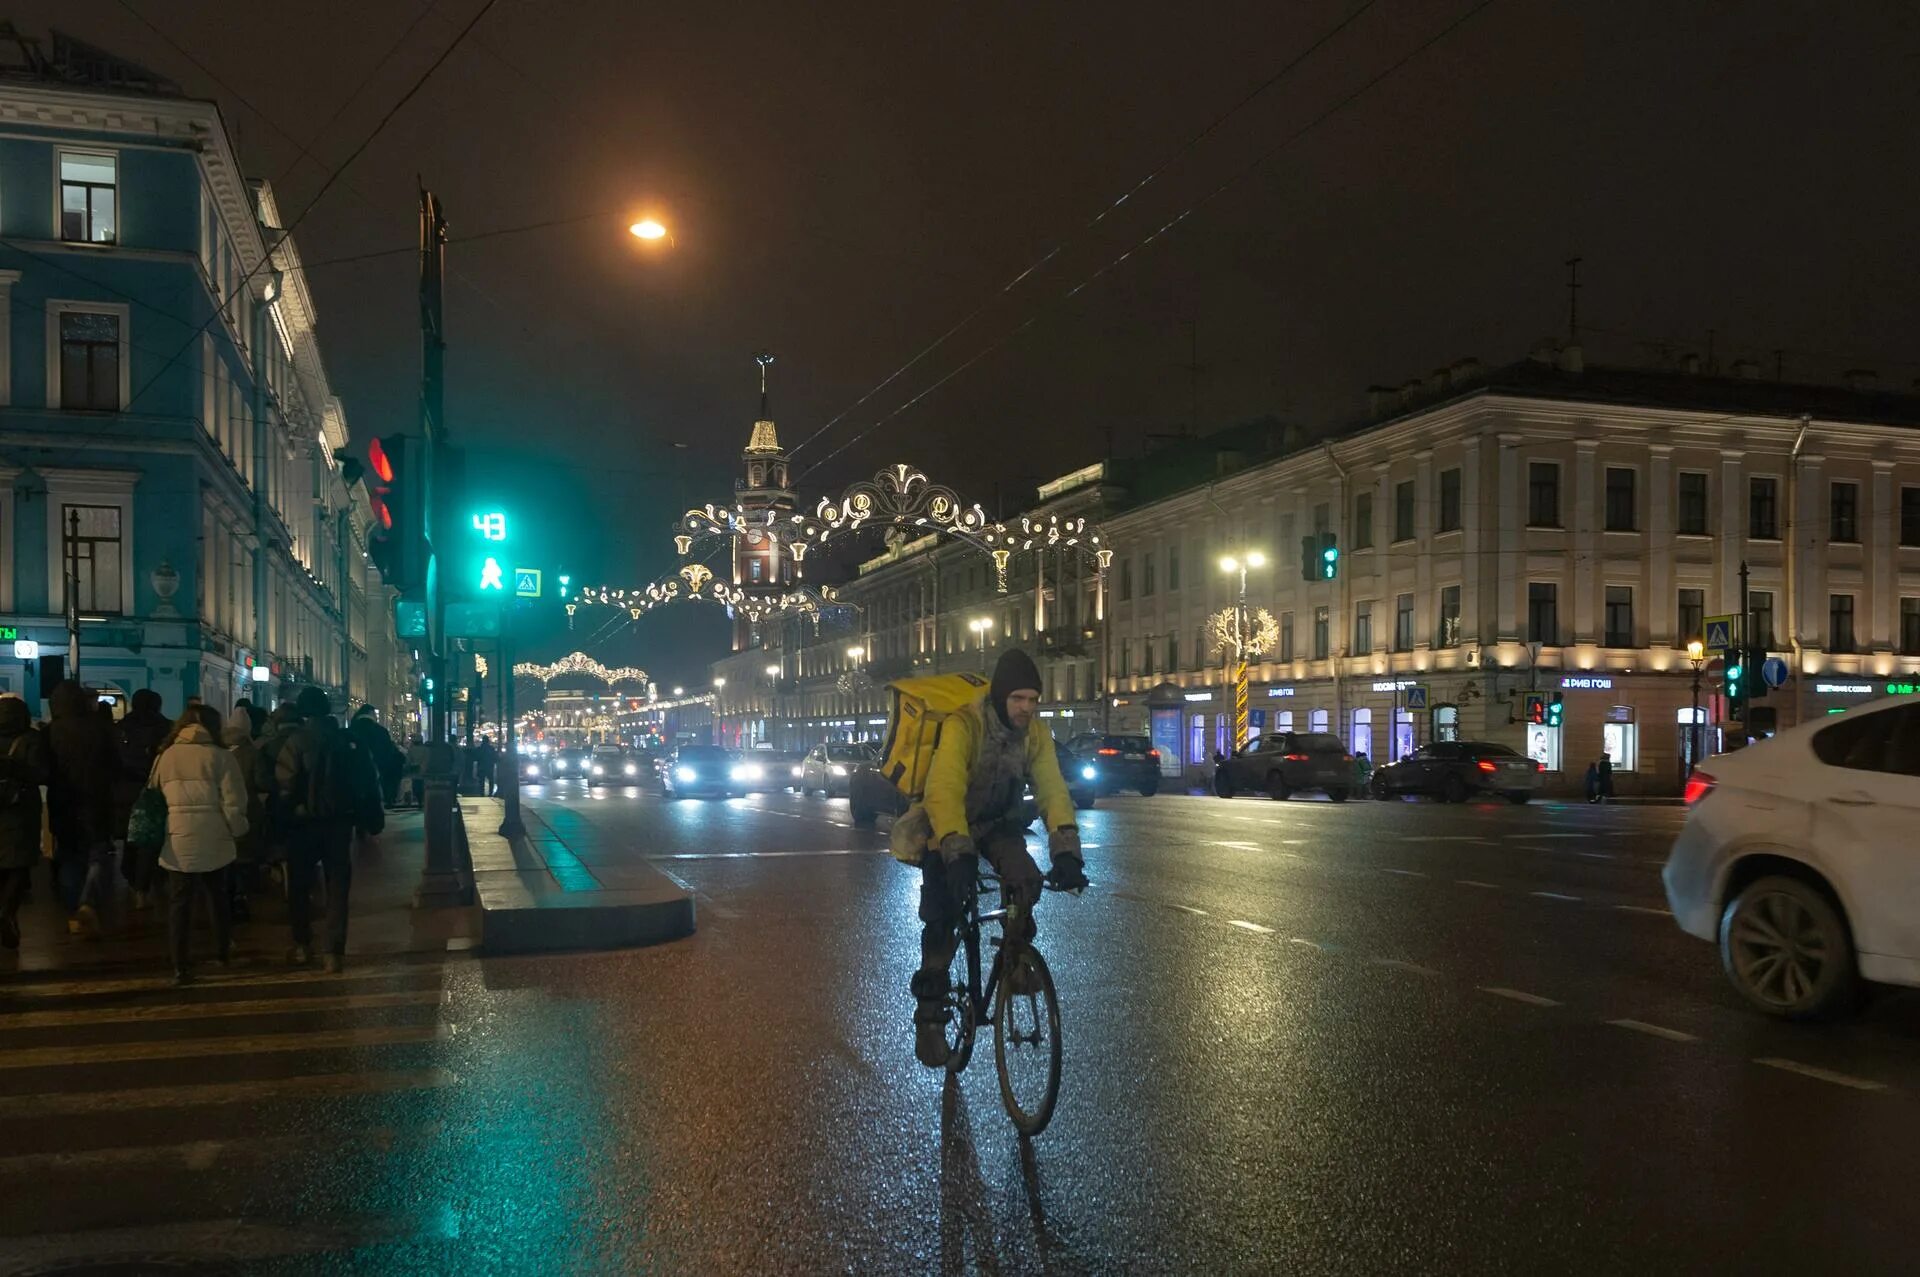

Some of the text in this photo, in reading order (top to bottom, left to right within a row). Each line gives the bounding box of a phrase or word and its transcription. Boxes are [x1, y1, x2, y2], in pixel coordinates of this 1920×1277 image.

[472, 512, 506, 541] 43
[1571, 679, 1611, 689] РИВ ГОШ
